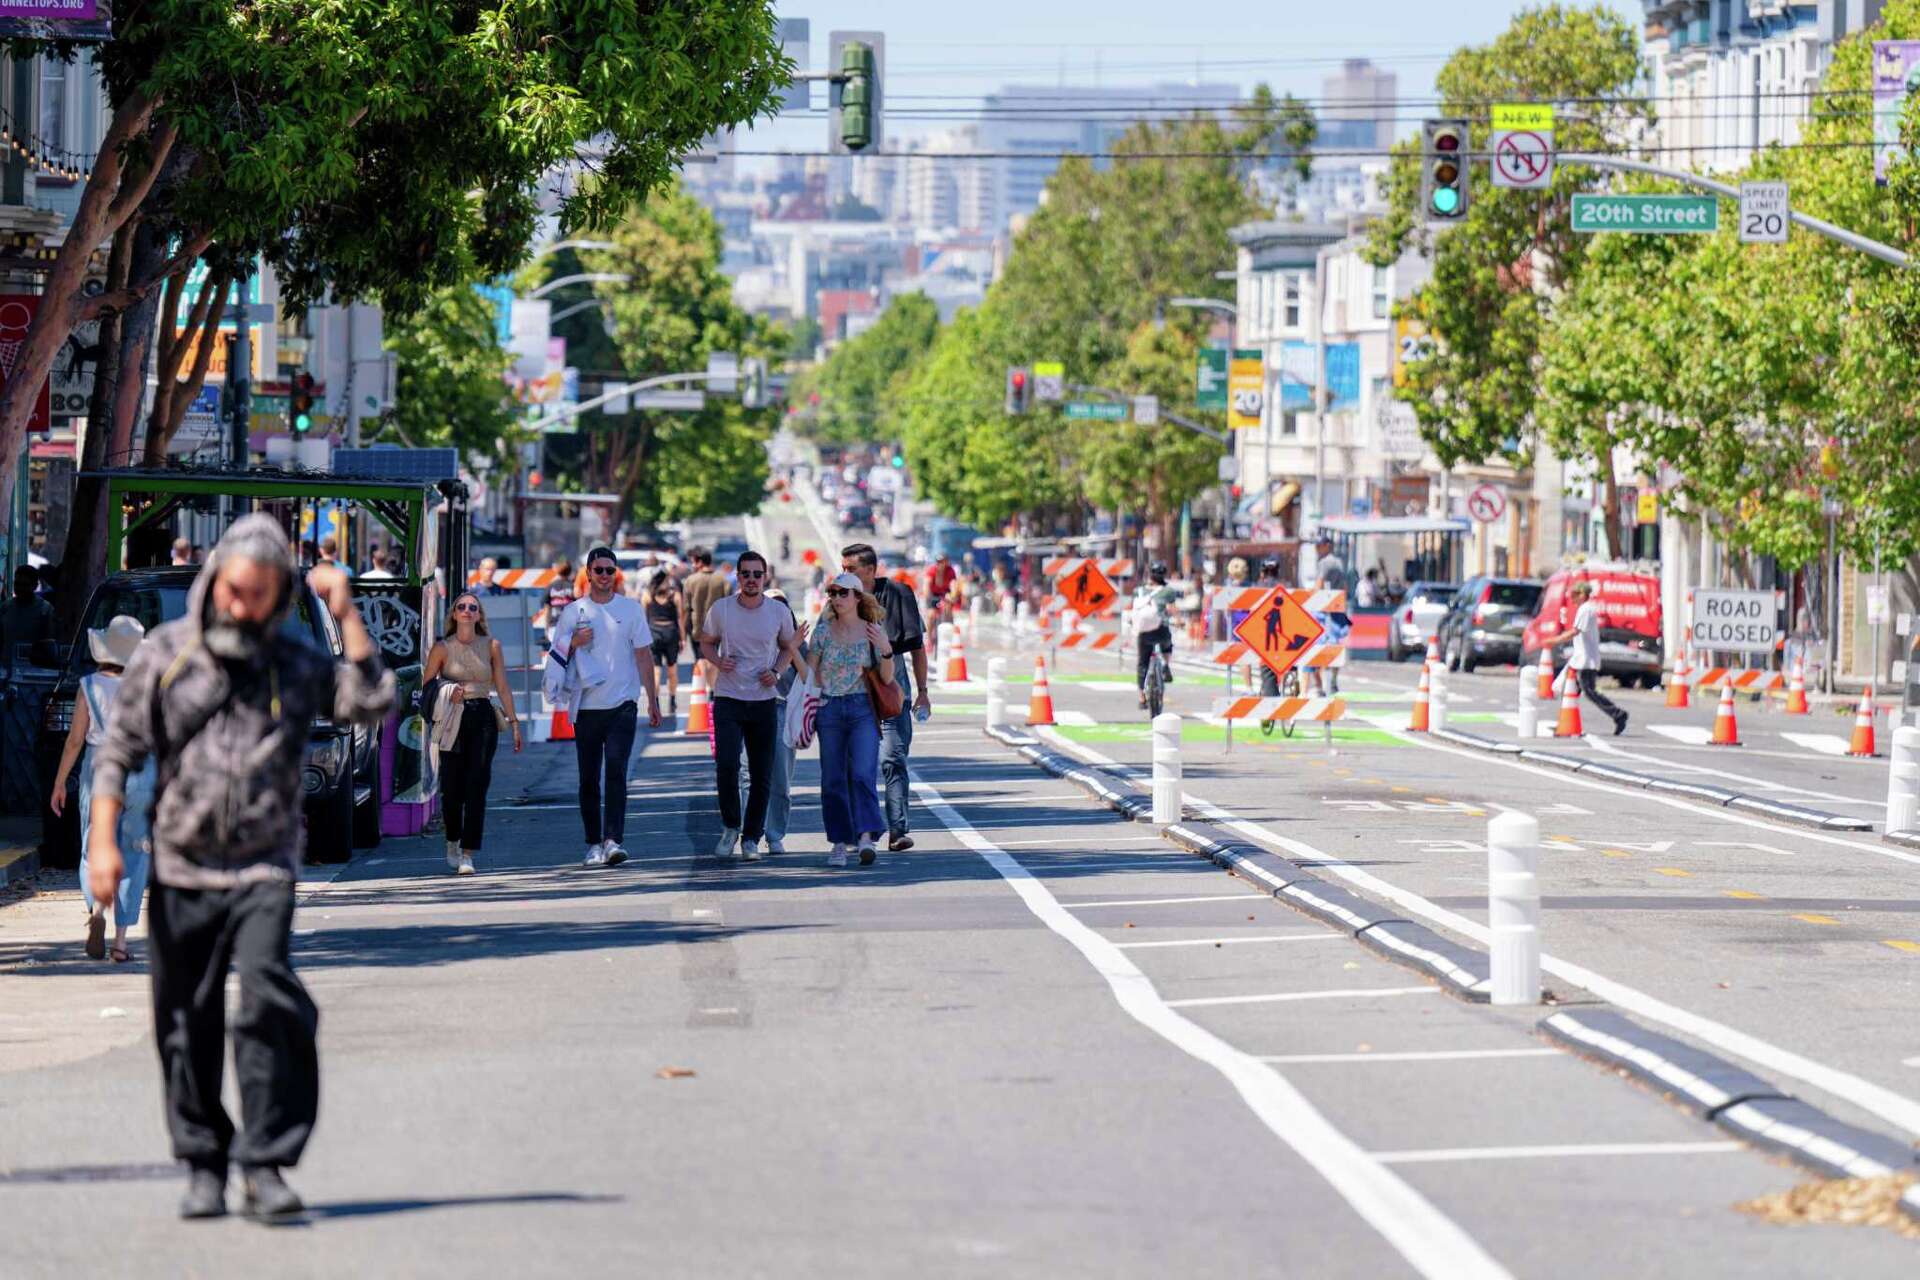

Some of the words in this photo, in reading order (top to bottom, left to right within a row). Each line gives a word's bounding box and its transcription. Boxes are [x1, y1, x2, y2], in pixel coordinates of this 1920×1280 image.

[1503, 112, 1541, 123] NEW
[1744, 188, 1784, 198] SPEED
[1581, 203, 1633, 223] 20th
[1640, 204, 1707, 223] Street
[1748, 200, 1778, 209] LIMIT
[1746, 213, 1782, 235] 20
[1233, 389, 1261, 411] 20
[1707, 599, 1761, 617] ROAD
[1694, 622, 1772, 642] CLOSED
